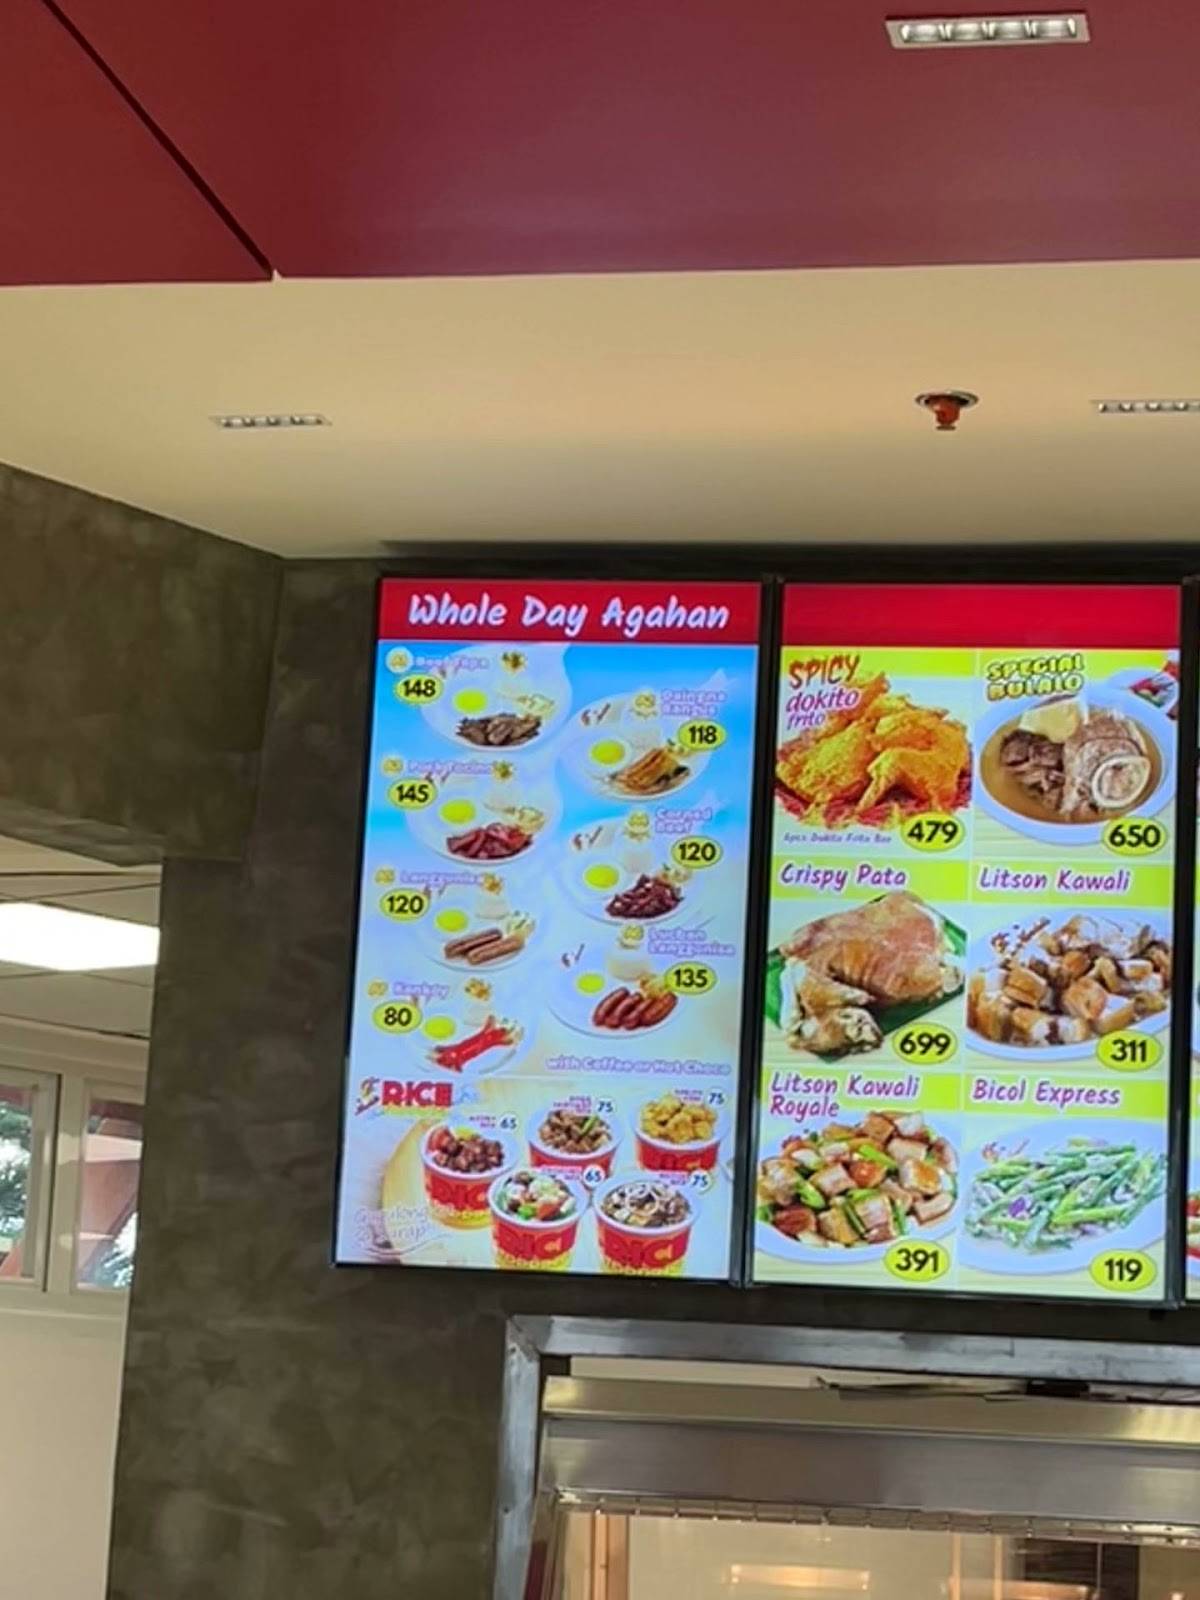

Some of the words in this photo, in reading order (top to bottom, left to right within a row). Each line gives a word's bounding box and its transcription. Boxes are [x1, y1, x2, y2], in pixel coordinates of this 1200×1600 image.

[408, 592, 508, 626] Whole
[521, 595, 588, 637] Day
[601, 595, 730, 638] Agahan
[789, 655, 860, 689] SPICY
[987, 653, 1084, 680] SPECIAL
[402, 679, 437, 698] 148
[987, 673, 1083, 701] BULALO
[785, 686, 859, 713] dokito
[787, 711, 826, 730] frito
[688, 725, 717, 745] 118
[395, 784, 430, 802] 145
[907, 820, 959, 844] 479
[1109, 825, 1161, 848] 650
[678, 842, 716, 861] 120
[781, 863, 848, 891] Crispy
[856, 864, 907, 885] Pata
[980, 868, 1047, 889] Litson
[1057, 869, 1130, 891] Kawali
[387, 895, 424, 914] 120
[674, 968, 708, 988] 135
[383, 1007, 413, 1027] 80
[900, 1031, 951, 1056] 699
[1111, 1039, 1148, 1062] 311
[771, 1072, 838, 1094] Litson
[847, 1075, 920, 1097] Kawali
[973, 1079, 1026, 1100] Bicol
[1036, 1081, 1120, 1108] Express
[598, 1101, 613, 1114] 75
[708, 1092, 724, 1105] 75
[770, 1095, 839, 1123] Royale
[500, 1117, 517, 1130] 65
[585, 1169, 602, 1183] 65
[691, 1174, 709, 1187] 75
[896, 1247, 939, 1273] 391
[1105, 1257, 1142, 1282] 119
